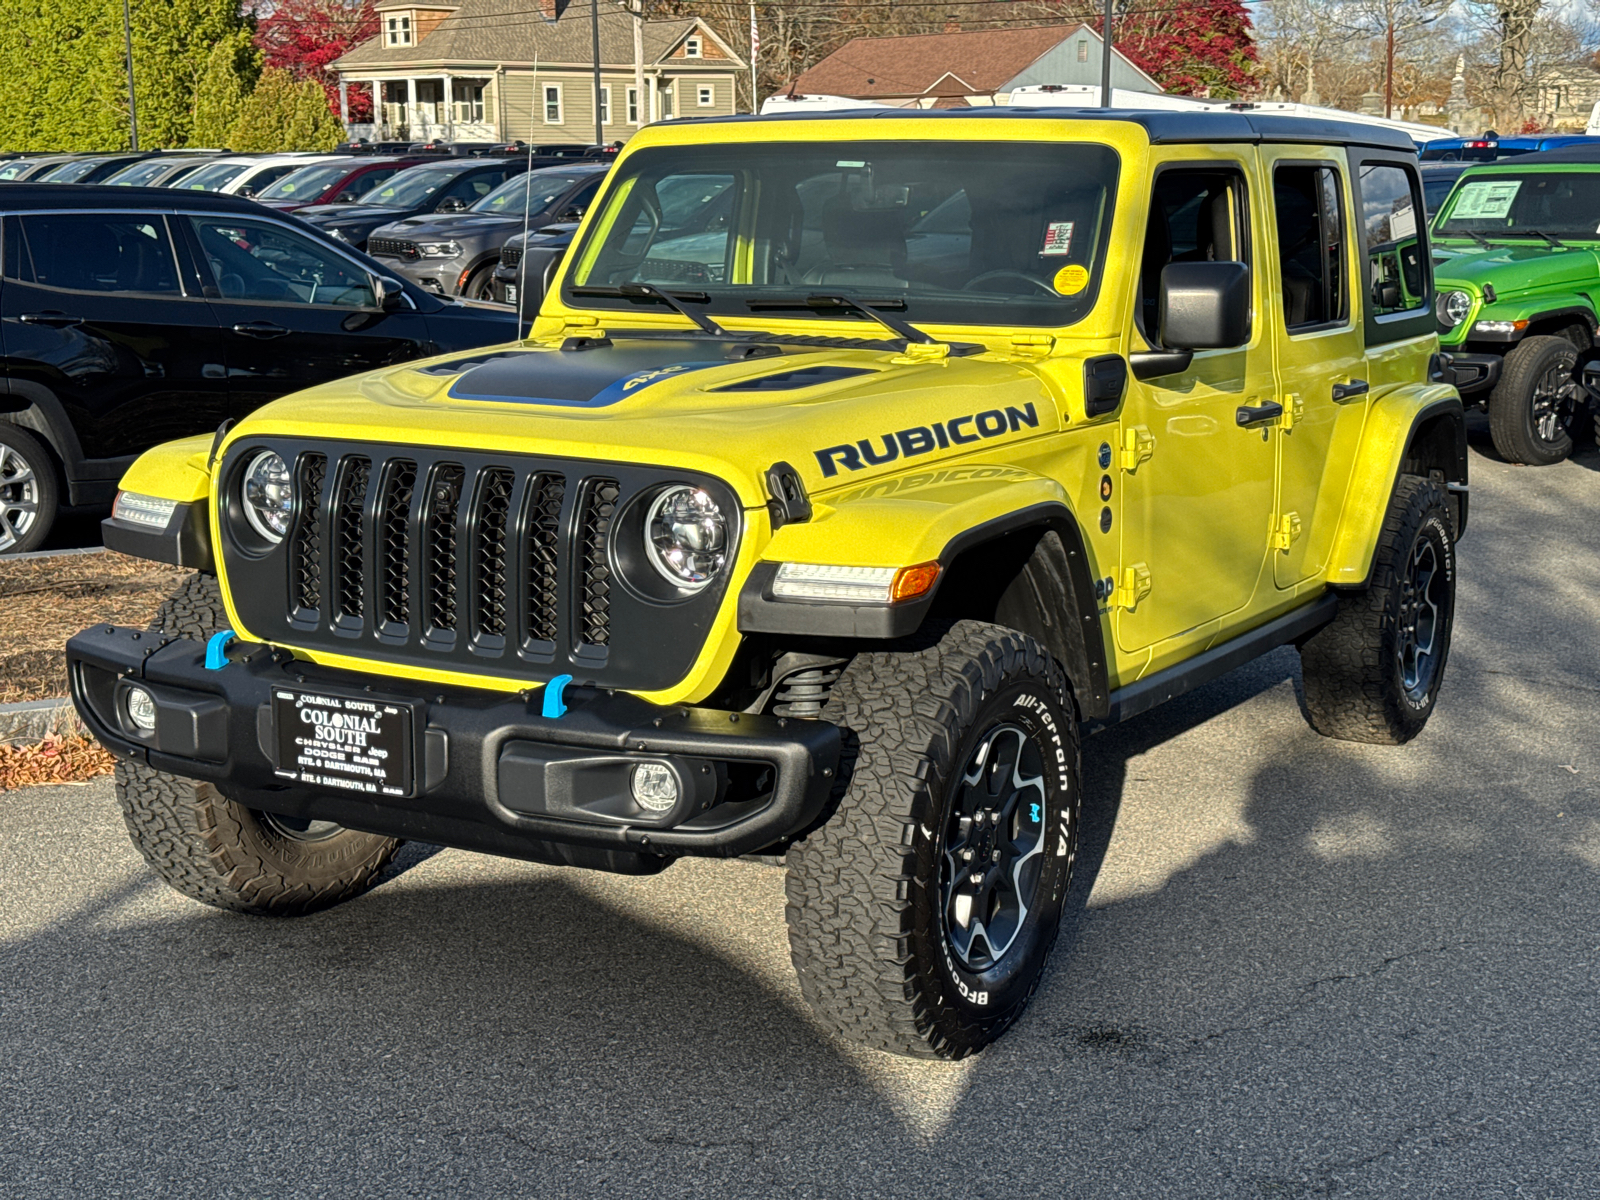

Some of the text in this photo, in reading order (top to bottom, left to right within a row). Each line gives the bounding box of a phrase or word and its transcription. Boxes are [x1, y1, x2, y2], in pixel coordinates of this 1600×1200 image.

[813, 402, 1040, 479] RUBICON
[300, 694, 342, 708] COLONIAL
[345, 701, 376, 712] SOUTH
[300, 708, 381, 734] COLONIAL
[315, 725, 367, 747] SOUTH
[295, 737, 389, 760] CHRYSLER Jeep
[304, 747, 346, 761] DODGE
[297, 756, 387, 778] RTE. 6 DARTMOUTH, MA
[1012, 693, 1069, 791] All-Terrain
[1056, 806, 1070, 857] T/A
[301, 773, 316, 784] RTE.
[323, 776, 365, 792] DARTMOUTH,
[365, 782, 377, 793] MA
